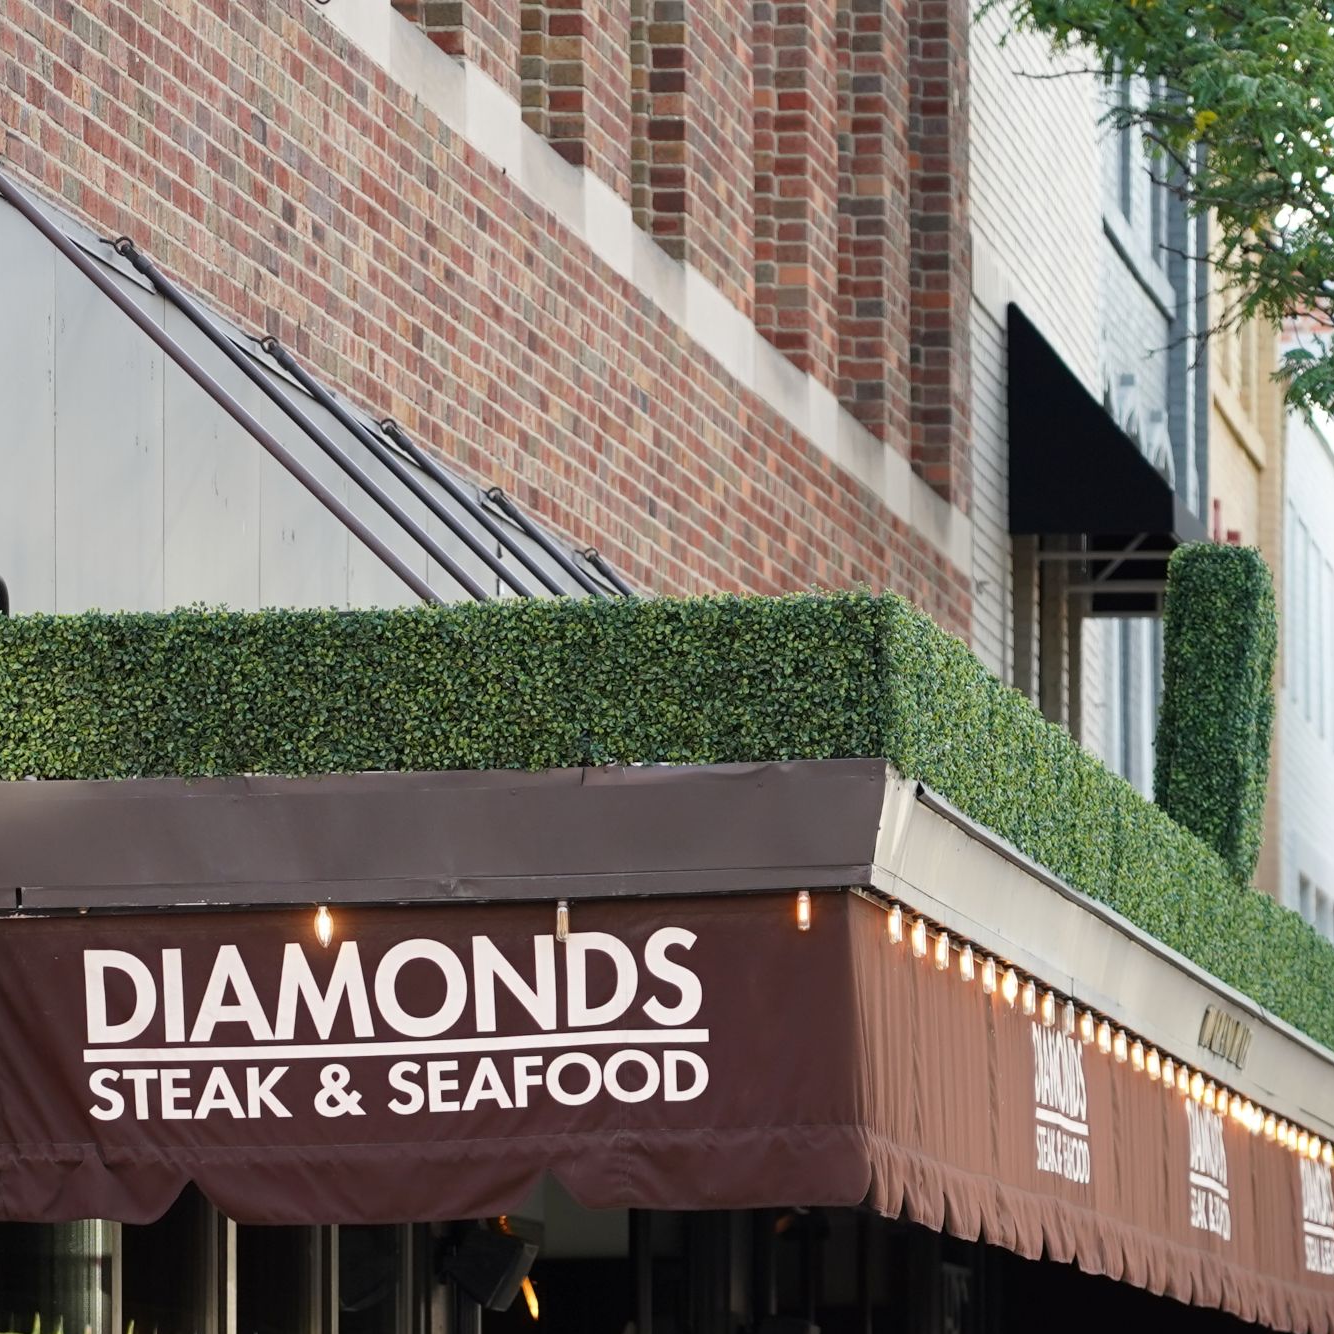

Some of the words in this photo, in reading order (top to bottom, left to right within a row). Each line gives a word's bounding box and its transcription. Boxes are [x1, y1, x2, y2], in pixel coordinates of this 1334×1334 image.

[83, 926, 703, 1044] DIAMONDS
[88, 1066, 294, 1121] STEAK
[313, 1063, 367, 1118] &
[387, 1049, 710, 1115] SEAFOOD
